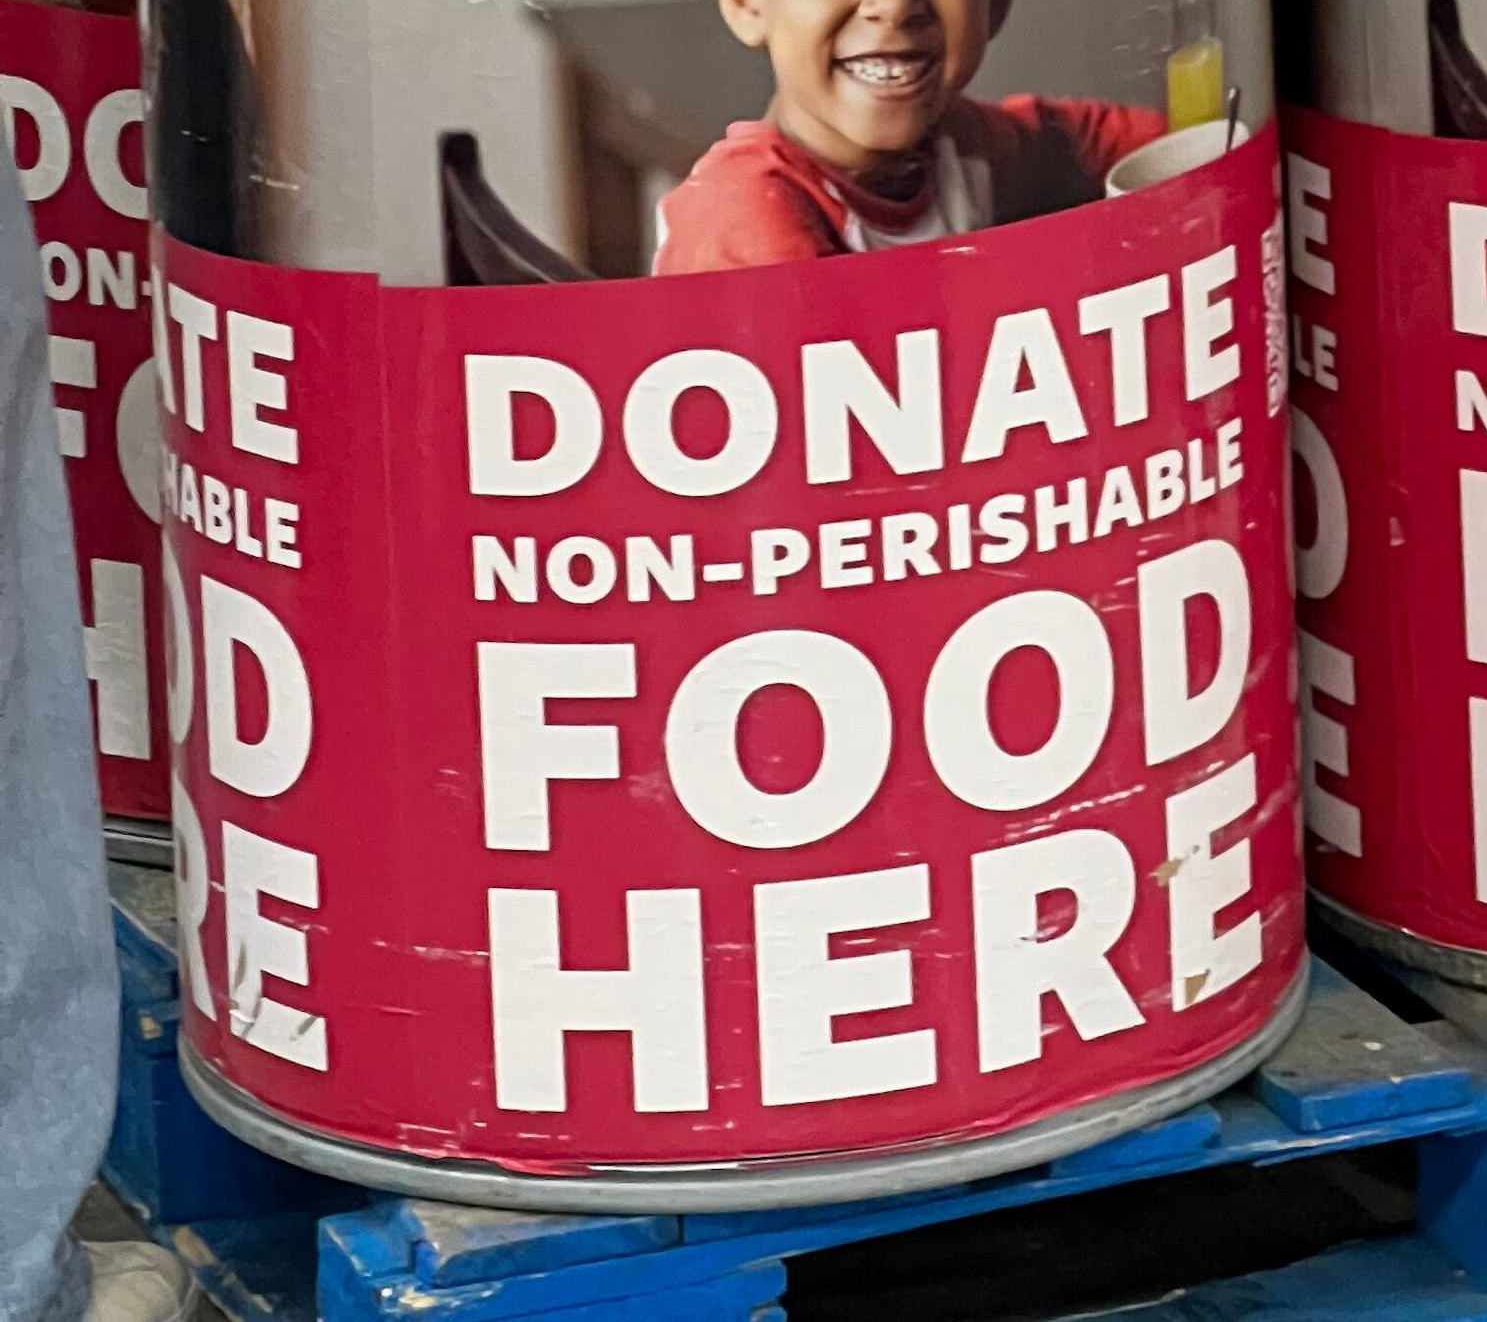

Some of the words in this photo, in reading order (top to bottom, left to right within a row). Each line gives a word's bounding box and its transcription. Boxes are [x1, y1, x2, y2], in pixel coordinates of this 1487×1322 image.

[464, 244, 1242, 497] DONATE
[472, 420, 1246, 605] NON-PERISHABLE
[477, 538, 1253, 850] FOOD
[486, 752, 1263, 1114] HERE
